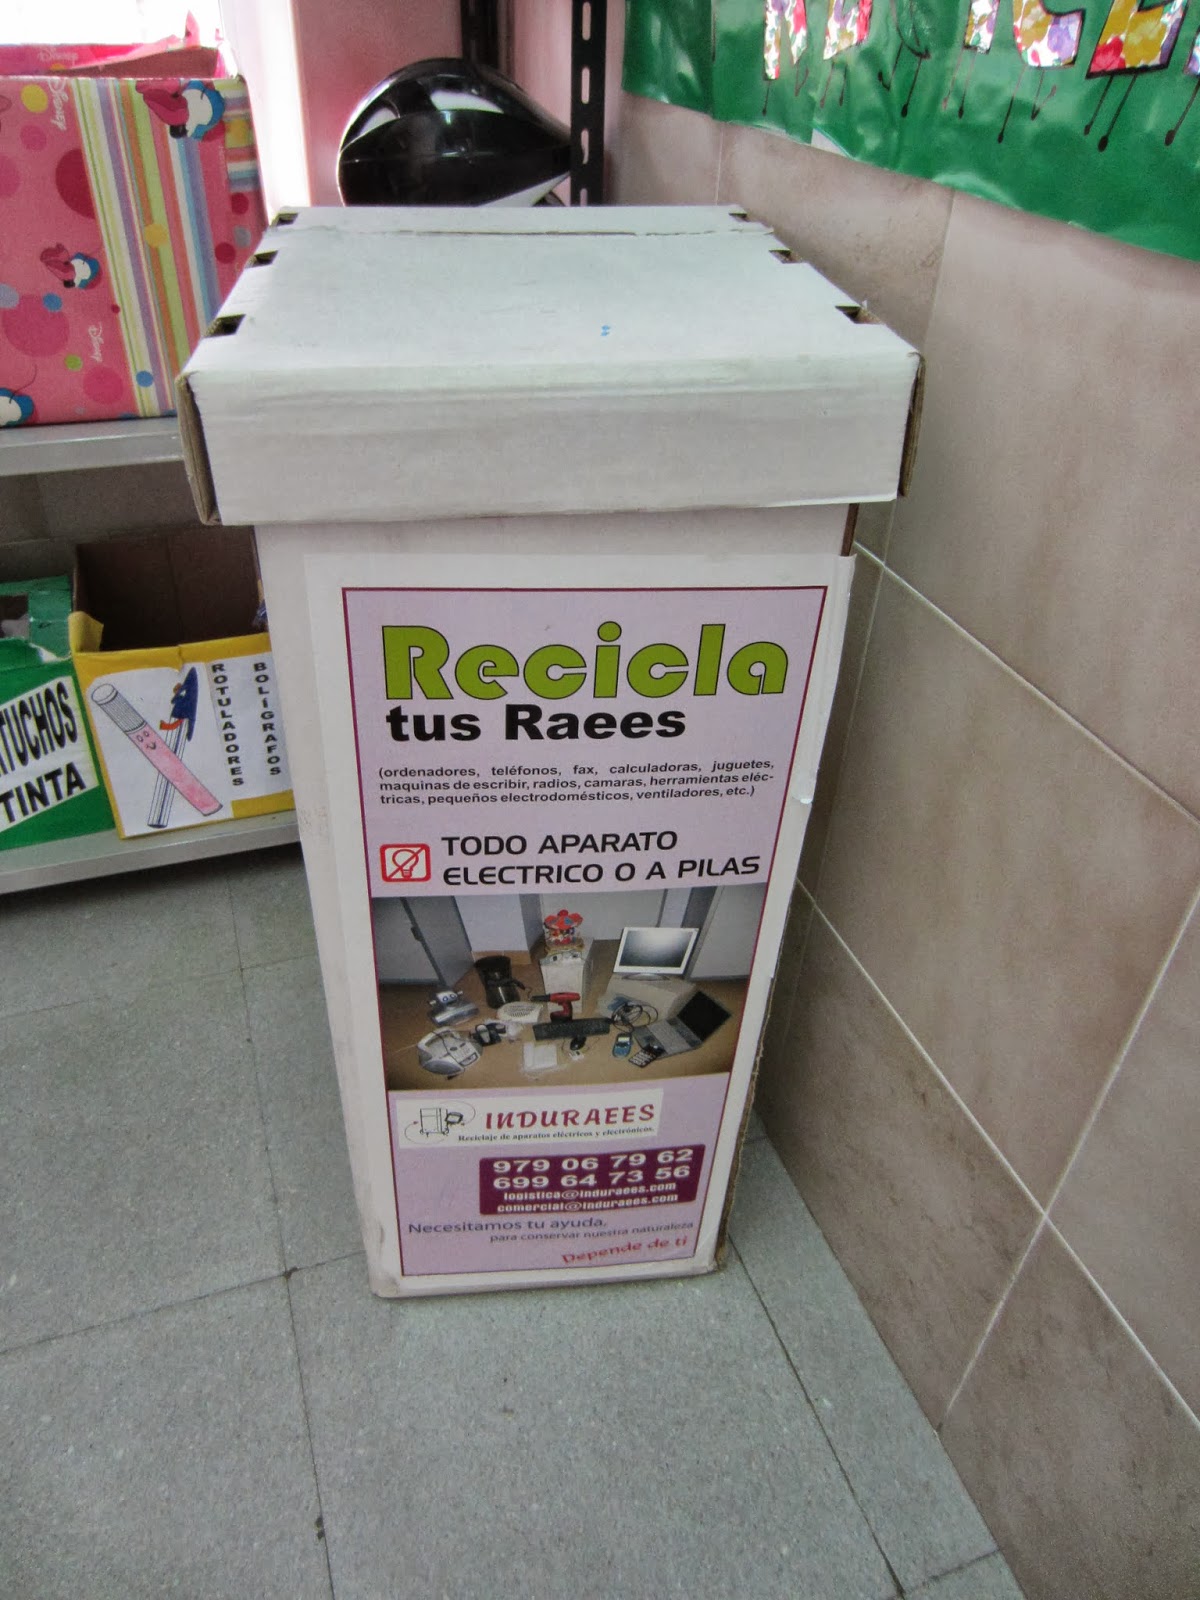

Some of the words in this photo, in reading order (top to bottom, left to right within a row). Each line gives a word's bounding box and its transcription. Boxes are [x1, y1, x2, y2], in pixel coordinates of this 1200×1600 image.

[381, 621, 789, 700] Recicla
[0, 681, 78, 777] TUCHOS
[211, 663, 244, 786] ROTULADORES
[386, 705, 482, 741] tus
[505, 703, 686, 740] Raees
[378, 767, 480, 779] (ordenadores,
[491, 765, 562, 777] teléfonos,
[573, 764, 598, 775] fax,
[609, 762, 702, 774] calculadoras,
[711, 760, 774, 772] juguetes,
[380, 781, 450, 792] maquinas
[453, 780, 470, 790] de
[473, 779, 530, 790] escribir,
[533, 779, 580, 789] radios,
[584, 778, 647, 788] camaras,
[650, 774, 739, 786] herramientas
[742, 772, 774, 783] eléc-
[0, 761, 87, 824] TINTA
[380, 794, 425, 805] tricas,
[428, 793, 498, 805] pequeños
[501, 789, 633, 803] electrodomésticos,
[636, 787, 723, 799] ventiladores,
[726, 785, 755, 797] etc.)
[442, 835, 527, 856] TODO
[538, 830, 678, 854] APARATO
[443, 862, 604, 886] ELECTRICO
[615, 862, 635, 881] O
[645, 861, 666, 880] A
[678, 856, 761, 880] PILAS
[485, 1104, 655, 1130] INDURAEES
[458, 1133, 498, 1142] Reciclaje
[512, 1132, 550, 1141] aparatos
[493, 1159, 550, 1173] 979
[561, 1157, 599, 1171] 06
[610, 1153, 647, 1169] 79
[656, 1148, 694, 1164] 62
[493, 1175, 550, 1189] 699
[560, 1173, 597, 1188] 64
[608, 1170, 643, 1185] 73
[654, 1165, 691, 1180] 56
[497, 1193, 679, 1213] comercial@induraees.com
[503, 1182, 677, 1201] logistica@induraees.com
[408, 1220, 522, 1234] Necesitamos
[527, 1219, 545, 1229] tu
[489, 1234, 517, 1244] para
[520, 1231, 580, 1241] conservar
[584, 1228, 629, 1238] nuestra
[632, 1221, 694, 1235] naturaleza
[561, 1240, 642, 1264] Depende
[647, 1237, 670, 1250] de
